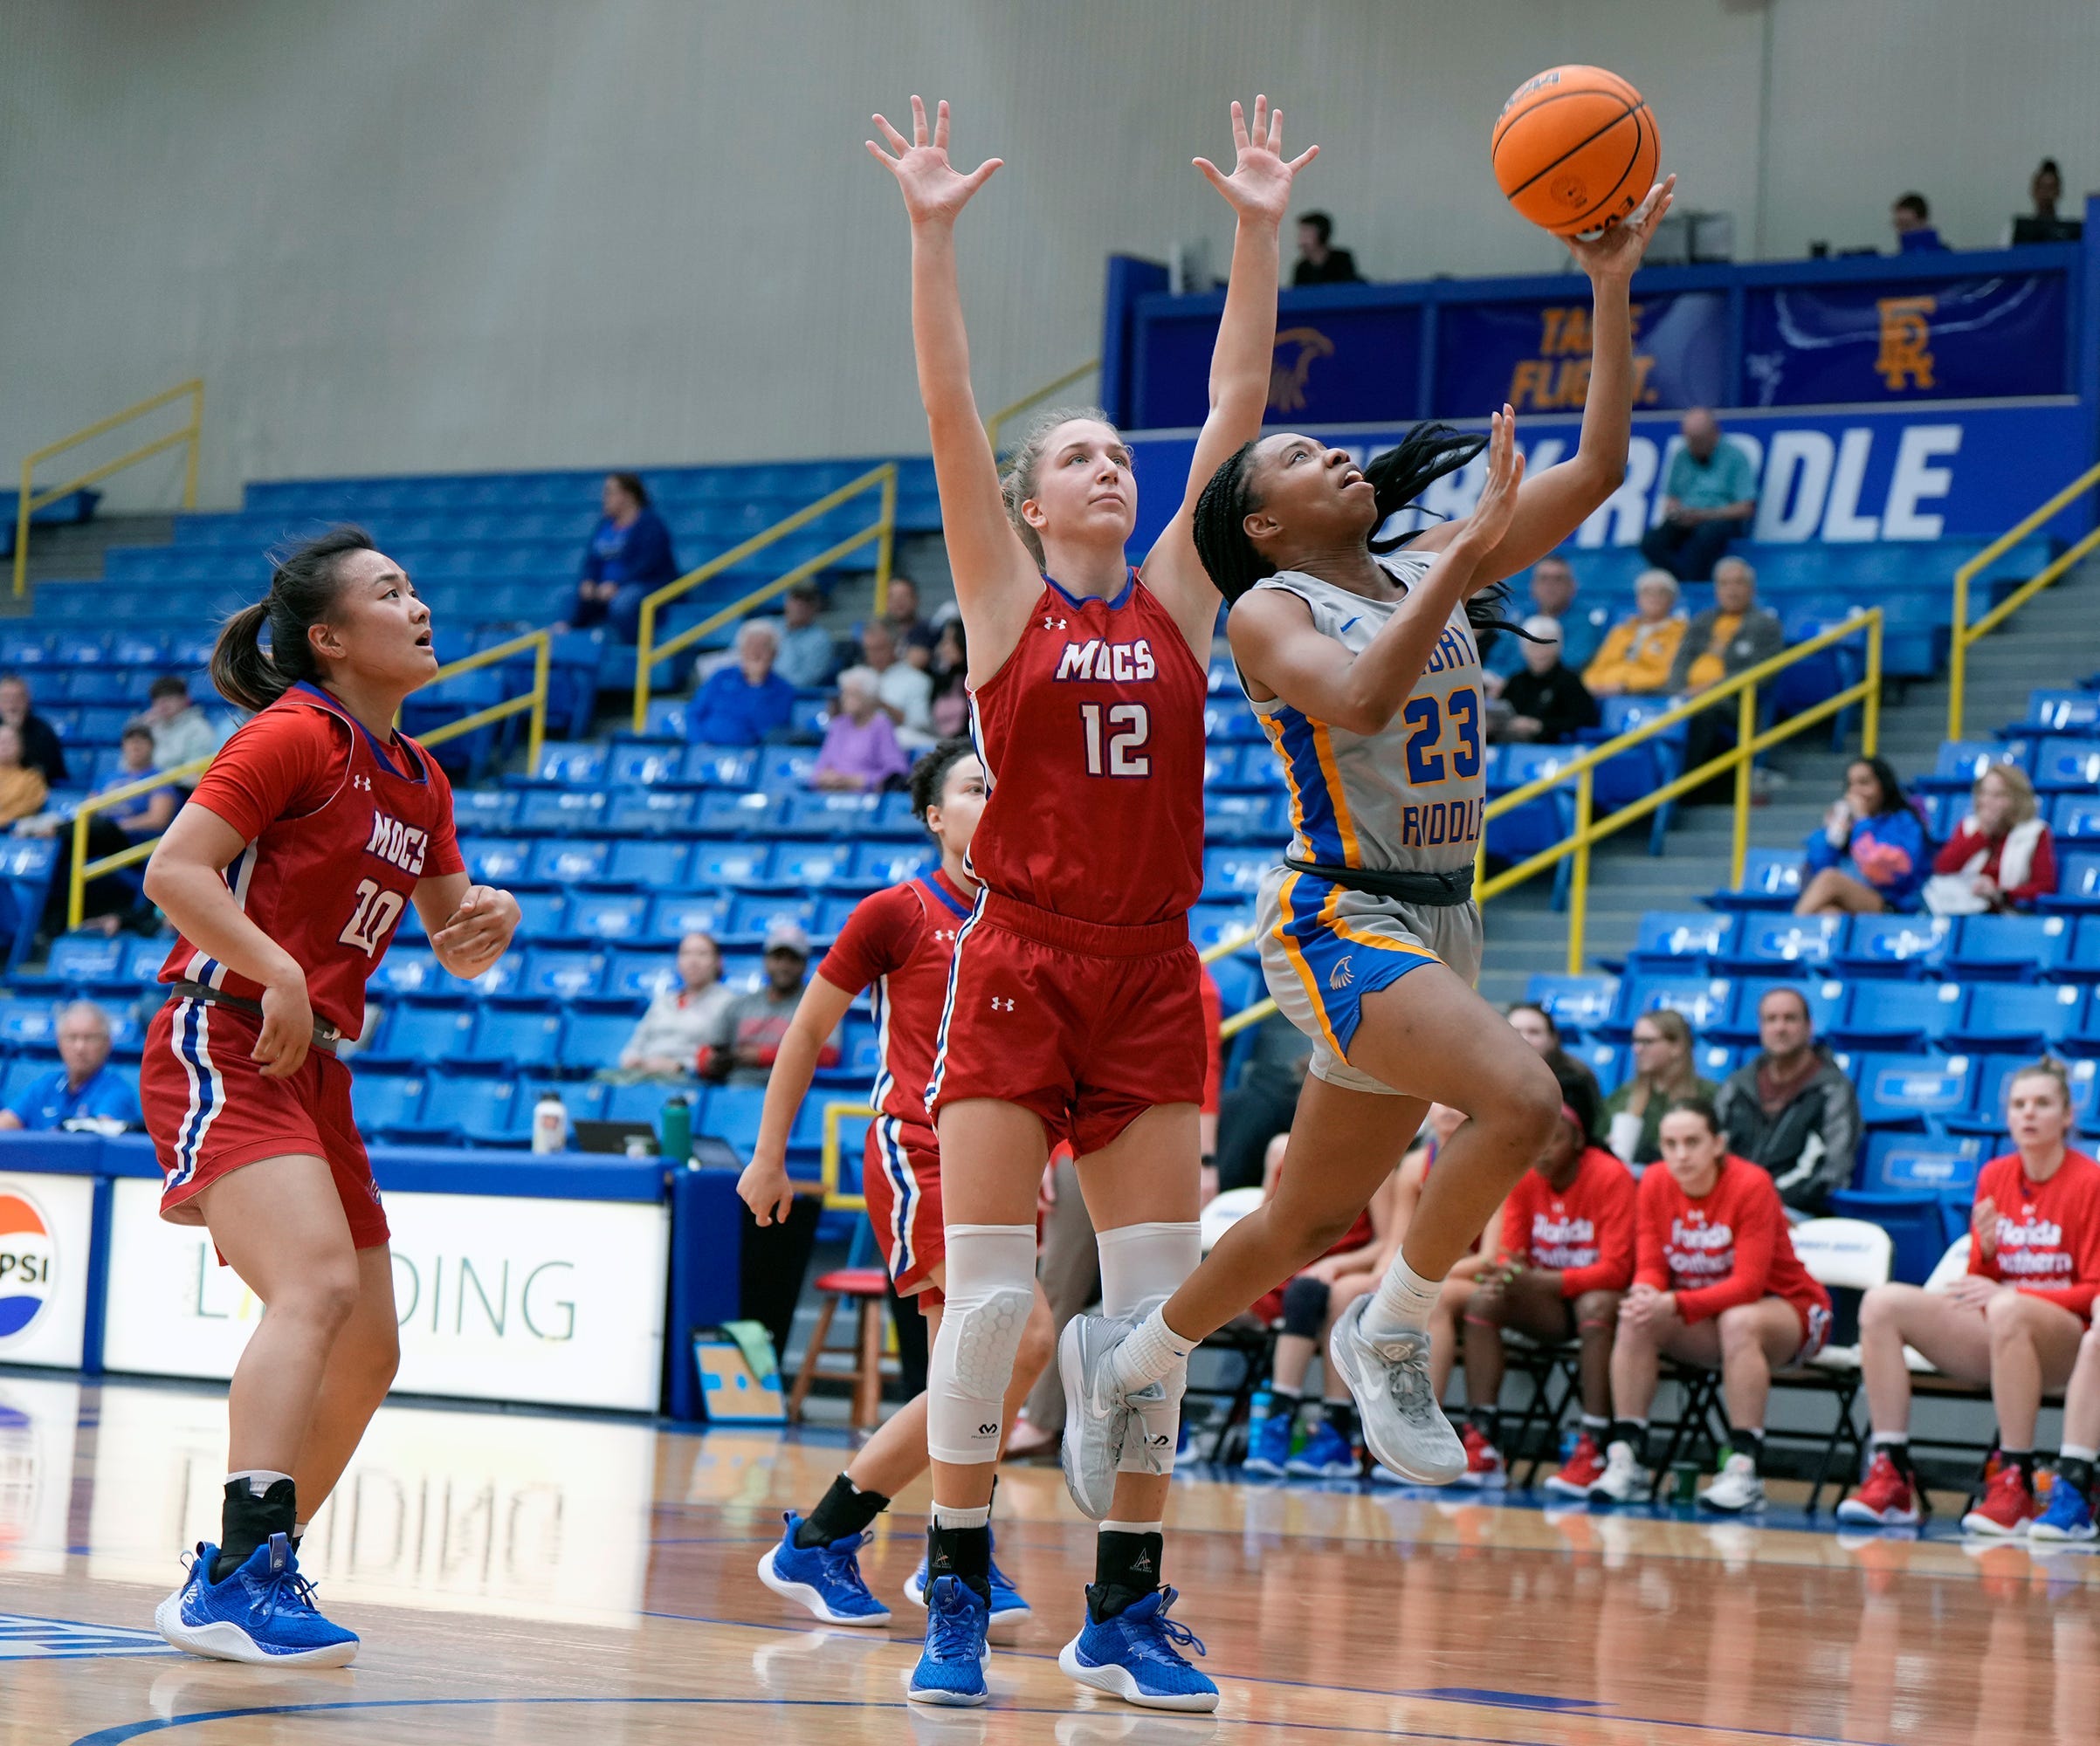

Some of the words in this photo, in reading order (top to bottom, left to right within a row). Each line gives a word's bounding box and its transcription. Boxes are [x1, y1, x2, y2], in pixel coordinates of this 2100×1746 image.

[1054, 637, 1158, 683] MOCS
[1078, 701, 1152, 779] 12
[1401, 684, 1480, 787] 23
[337, 875, 407, 959] 20
[0, 1254, 48, 1282] PSI
[197, 1241, 575, 1342] LDING
